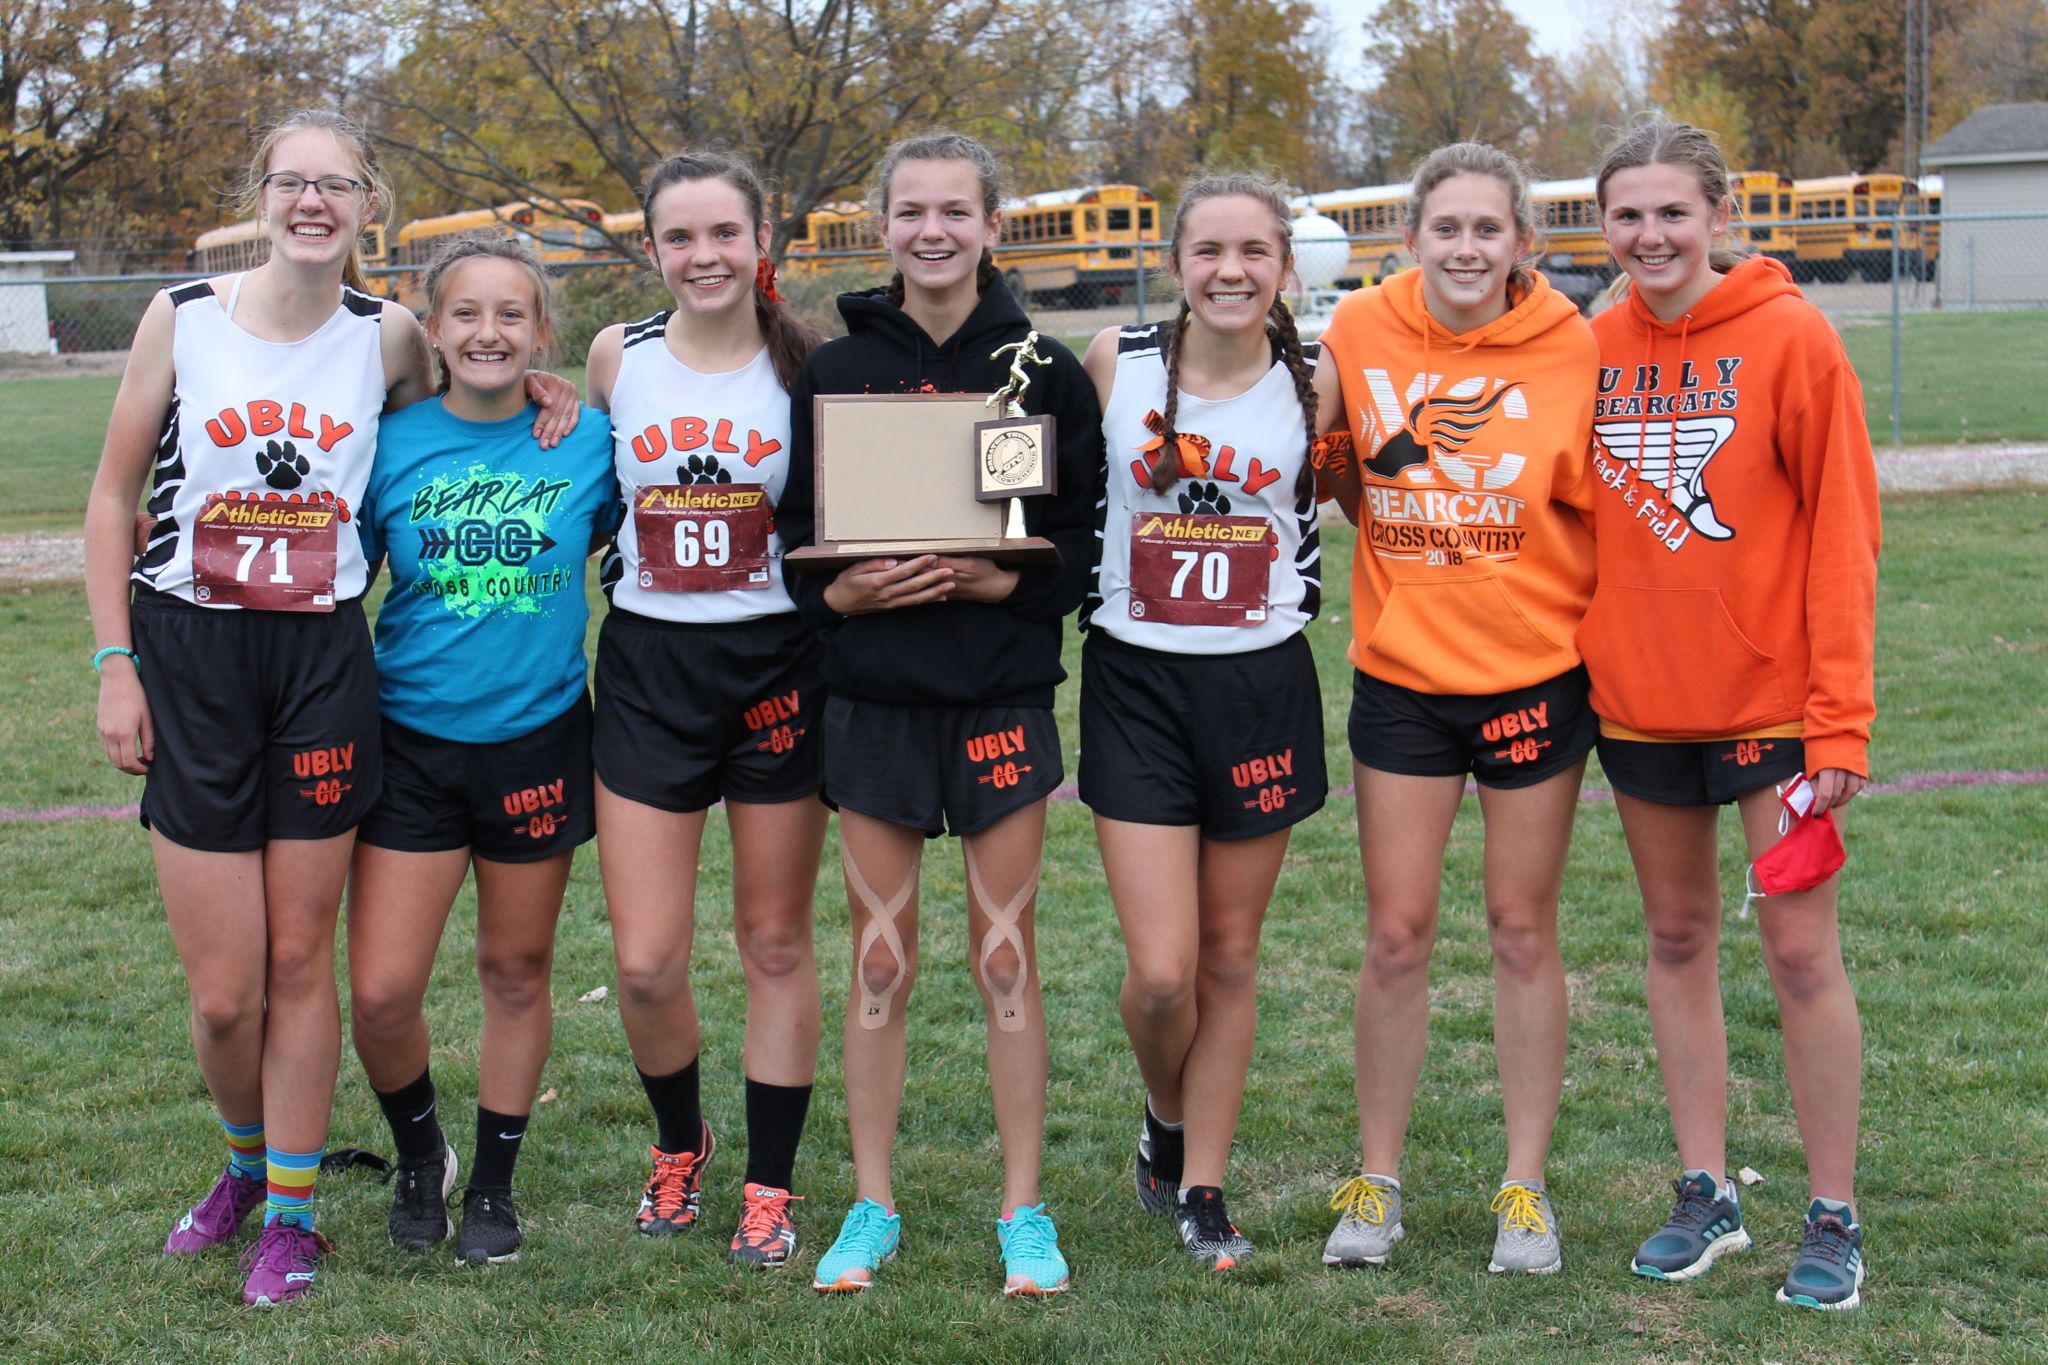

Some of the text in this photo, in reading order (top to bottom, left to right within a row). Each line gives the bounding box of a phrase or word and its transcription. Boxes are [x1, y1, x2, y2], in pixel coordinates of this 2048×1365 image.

[1598, 356, 1742, 393] UBLY
[1594, 389, 1738, 419] BEARCATS
[205, 400, 353, 452] UBLY
[631, 416, 782, 467] UBLY
[411, 479, 571, 522] BEARCAT
[1366, 487, 1525, 525] BEARCAT
[1623, 484, 1638, 507] &
[674, 519, 730, 567] 69
[1370, 520, 1426, 547] CROSS
[236, 535, 293, 584] 71
[1170, 551, 1229, 600] 70
[1425, 549, 1463, 566] 2018
[486, 570, 571, 597] COUNTRY
[744, 690, 799, 730] UBLY
[1482, 702, 1548, 741] UBLY
[293, 742, 354, 777] UBLY
[966, 724, 1025, 762] UBLY
[1232, 749, 1292, 788] UBLY
[504, 778, 564, 816] UBLY
